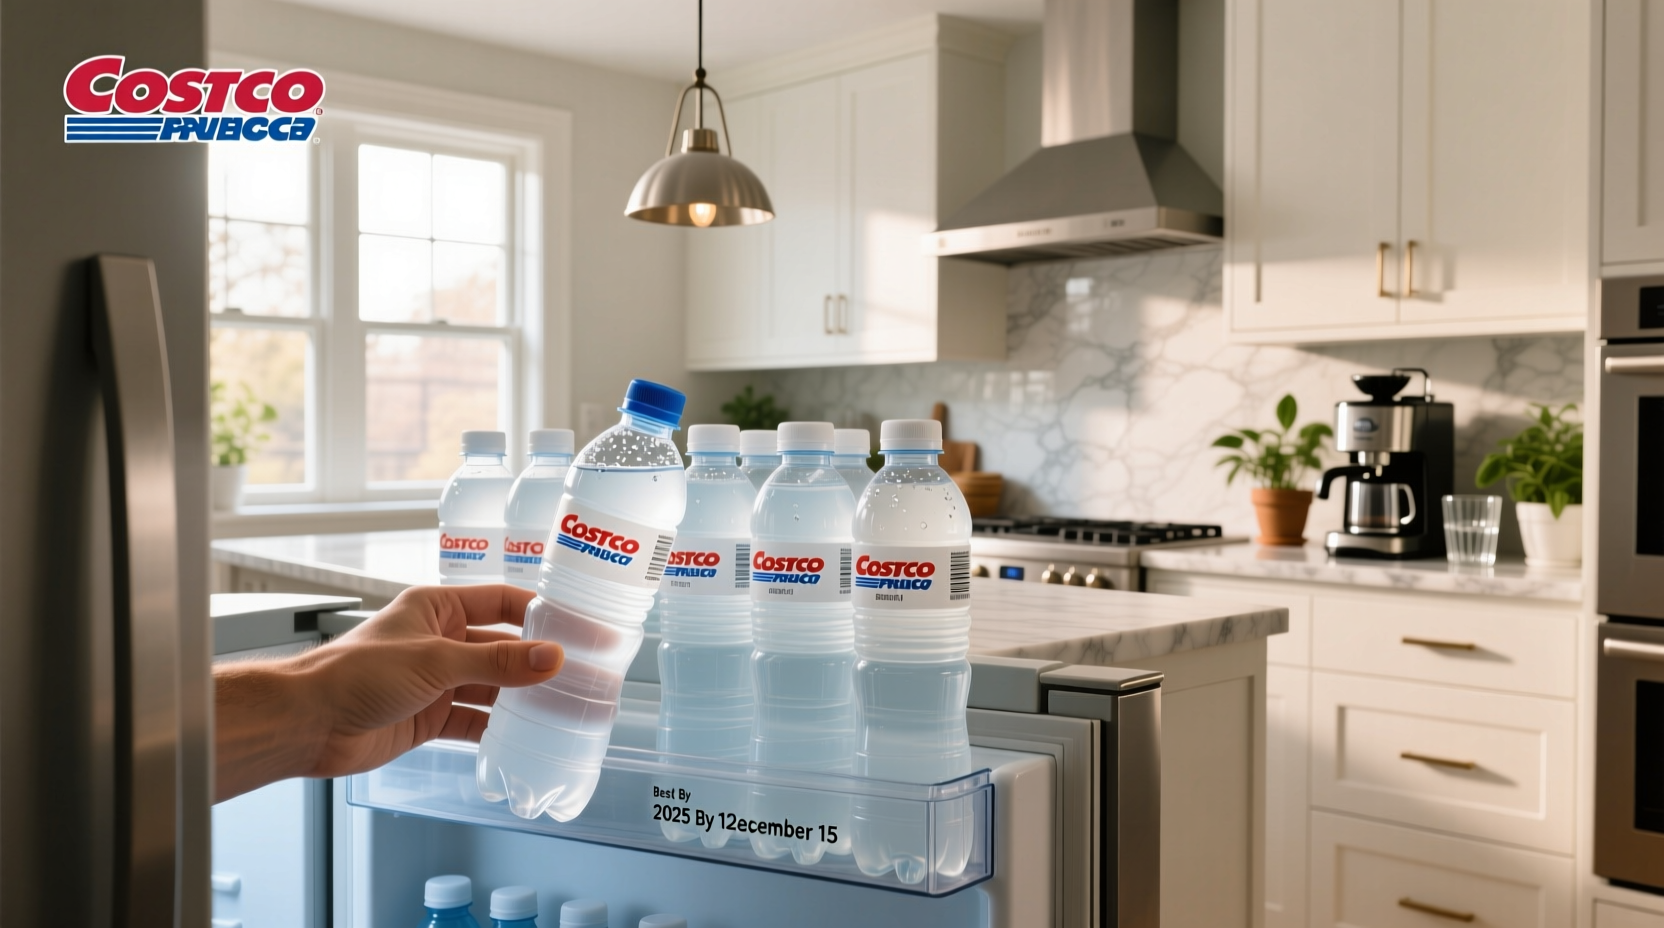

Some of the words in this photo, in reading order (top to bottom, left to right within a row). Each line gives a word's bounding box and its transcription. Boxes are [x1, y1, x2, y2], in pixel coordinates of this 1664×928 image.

[561, 513, 640, 554] COSTCO
[667, 551, 721, 567] OSTCO
[753, 550, 825, 573] COSTCO
[856, 555, 936, 578] COSTCO
[653, 785, 676, 800] Best
[678, 788, 692, 803] By
[653, 804, 691, 824] 2025
[695, 809, 715, 832] By
[718, 812, 814, 840] 12ecember
[818, 824, 838, 843] 15
